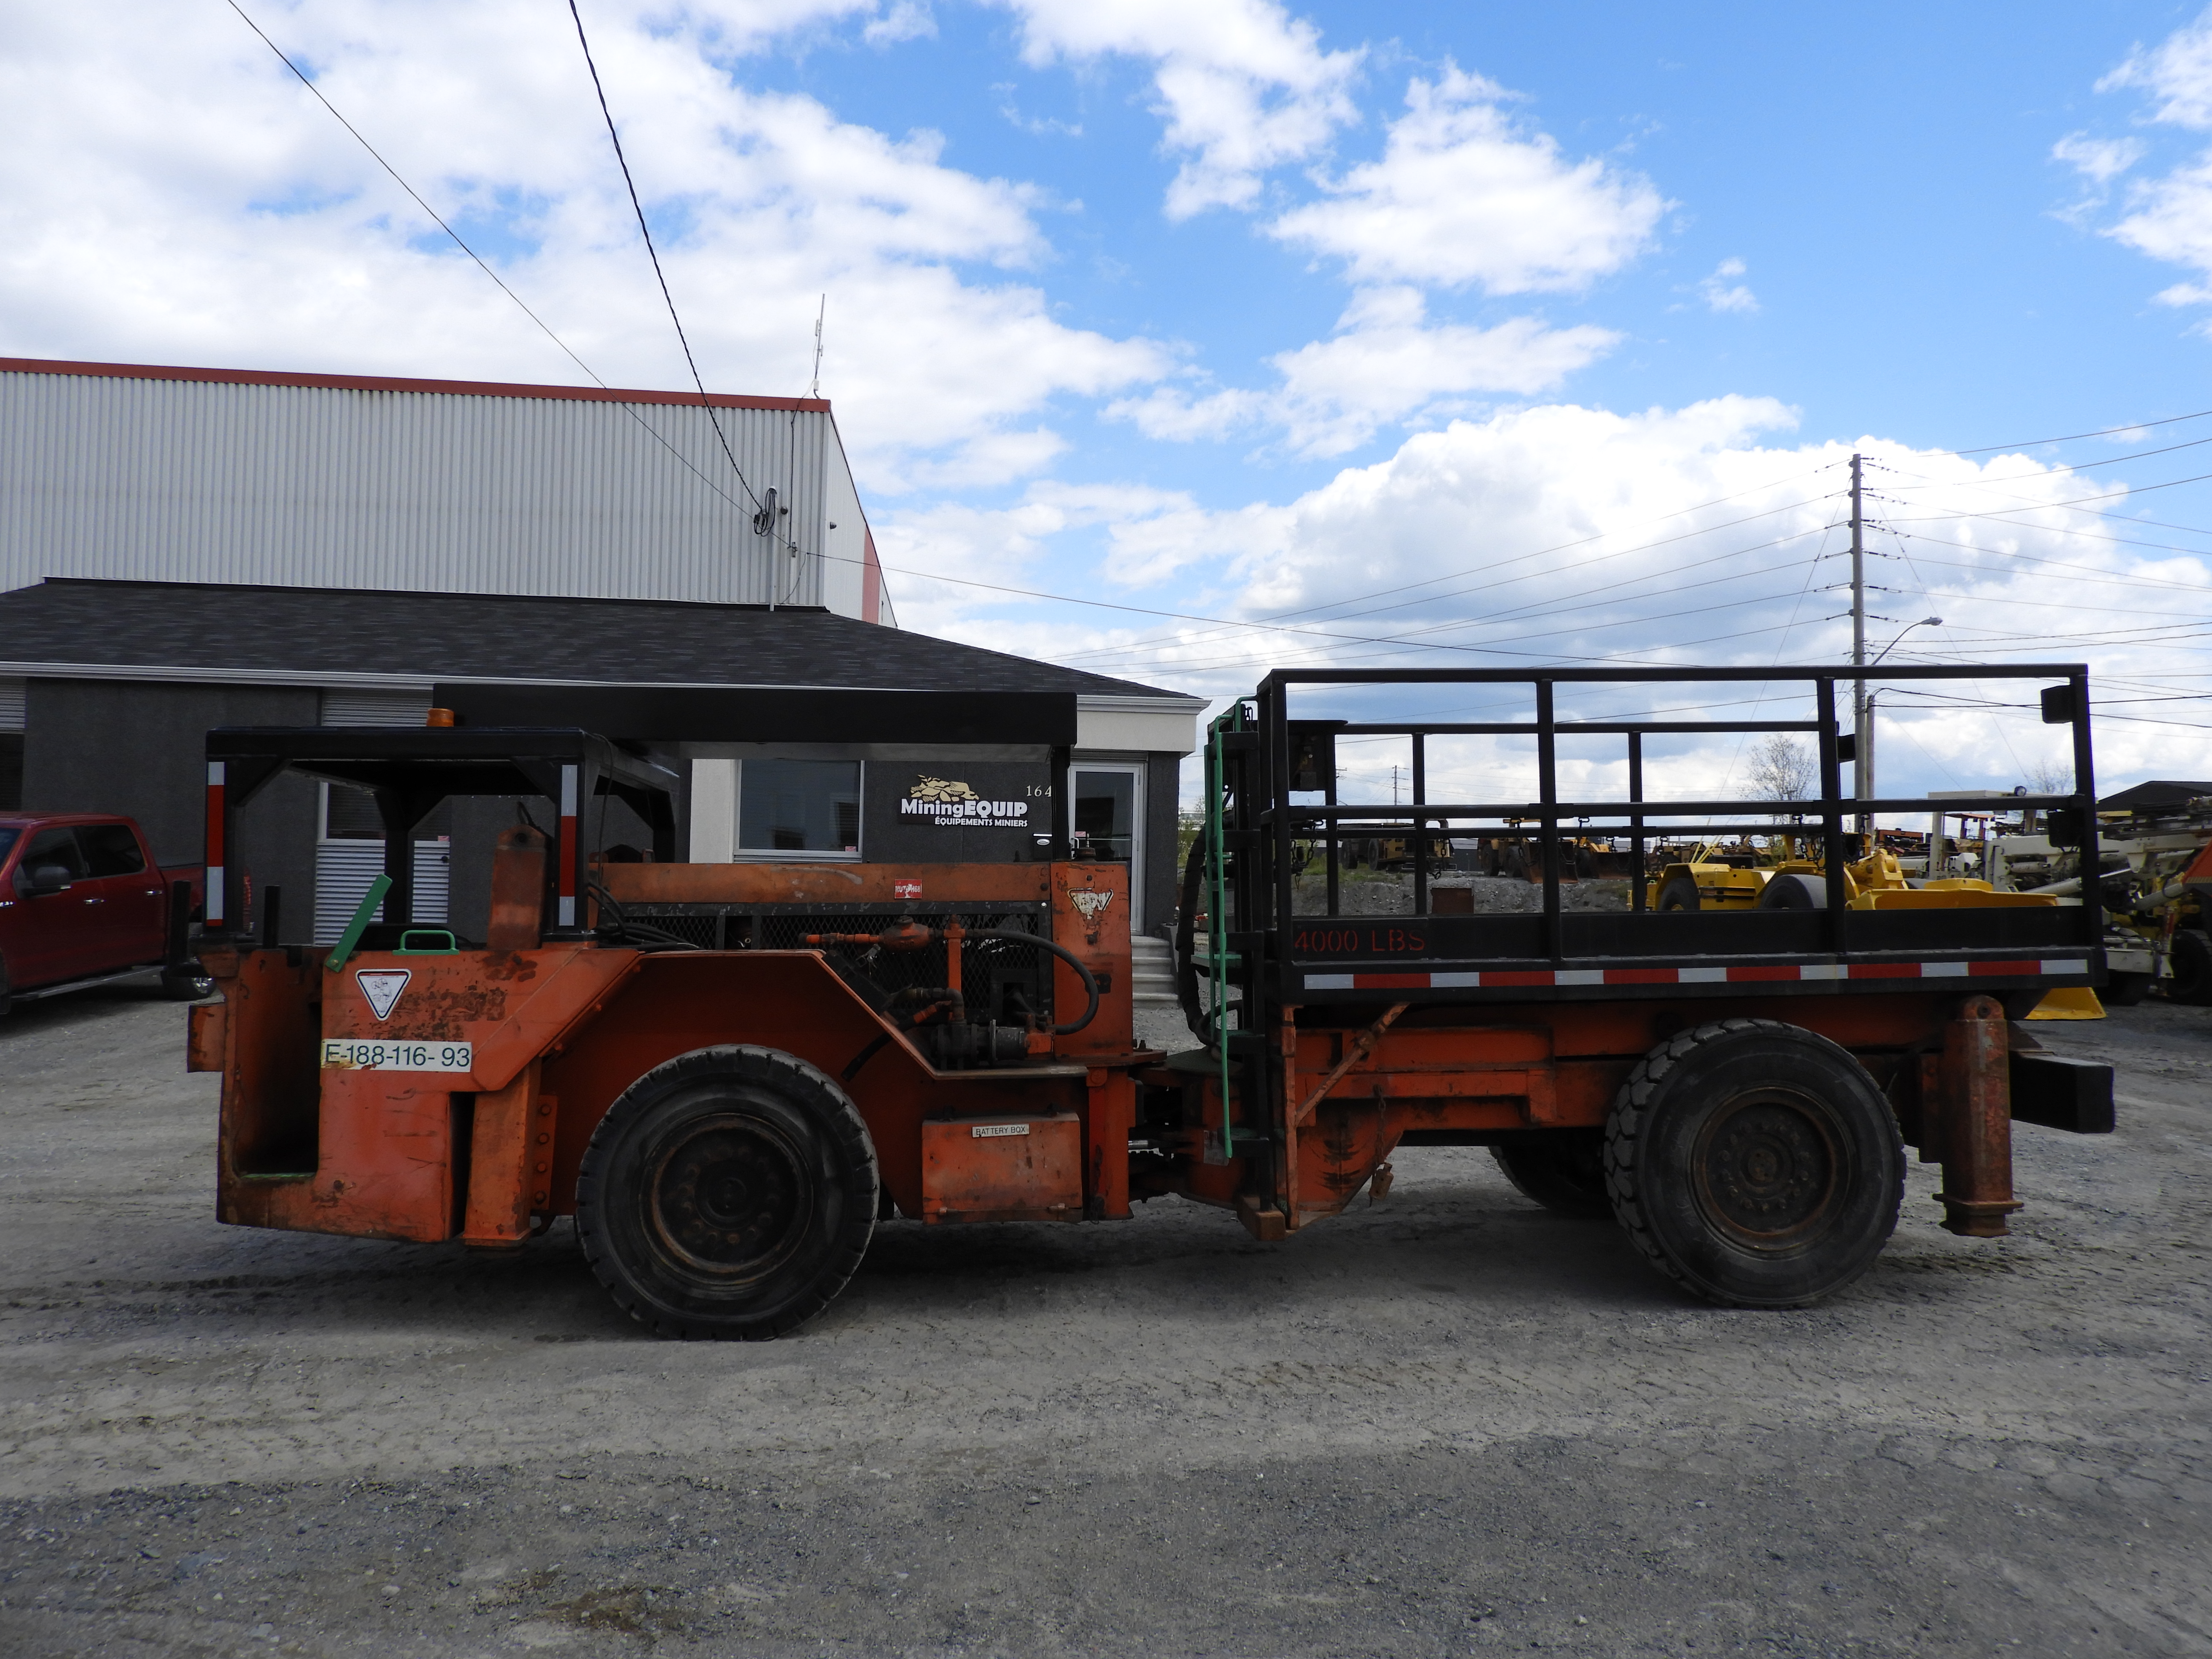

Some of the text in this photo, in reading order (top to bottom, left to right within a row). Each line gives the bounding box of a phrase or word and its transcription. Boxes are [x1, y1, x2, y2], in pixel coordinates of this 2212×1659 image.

[1026, 785, 1051, 797] 164
[901, 798, 1028, 818] MiningEQUIP
[934, 816, 993, 826] ÉQUIPEMENTS
[1294, 929, 1426, 952] 4000 LBS
[976, 1127, 1008, 1135] BATTERY
